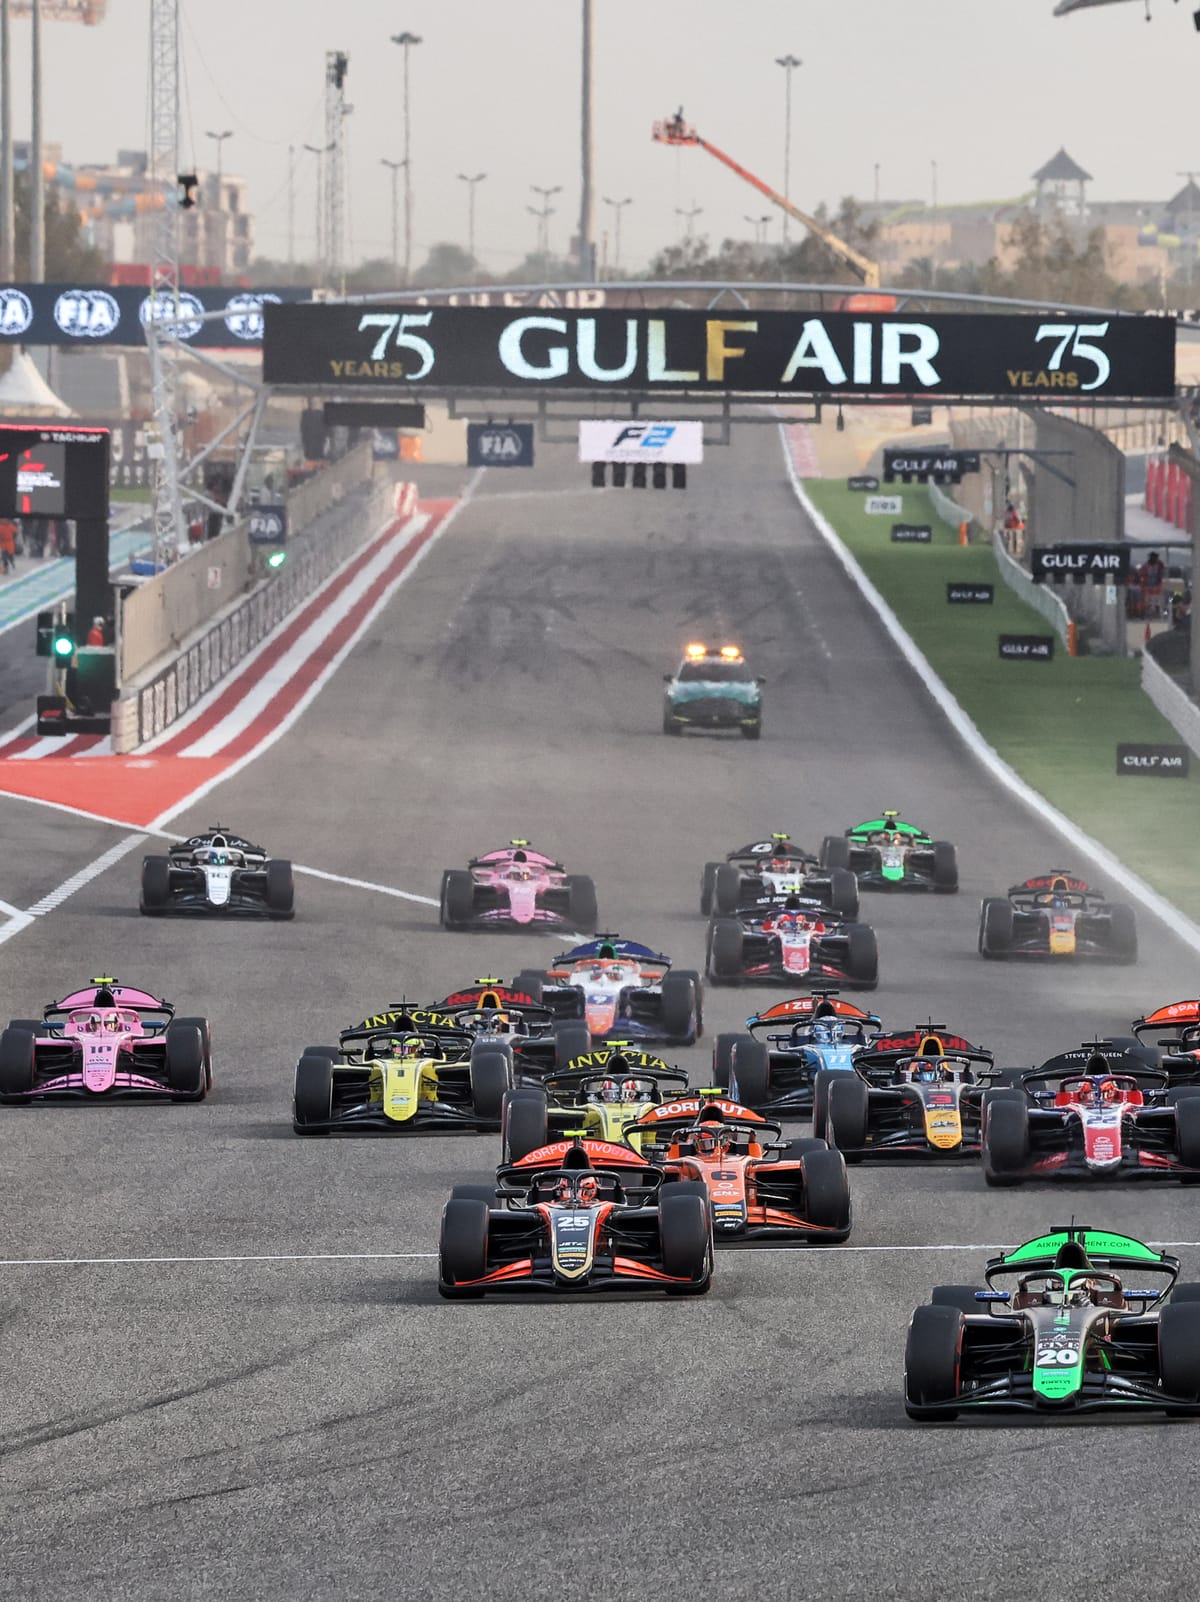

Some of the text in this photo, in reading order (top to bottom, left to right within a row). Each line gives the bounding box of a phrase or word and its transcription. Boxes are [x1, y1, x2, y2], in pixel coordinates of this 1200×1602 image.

[357, 311, 435, 380] 75
[499, 316, 941, 387] GULF AIR
[1034, 321, 1111, 390] 75
[330, 360, 402, 379] YEARS
[1007, 370, 1079, 388] YEARS
[613, 426, 676, 448] F2
[892, 458, 957, 471] GULF AIR
[1041, 554, 1120, 568] GULF AIR
[1123, 755, 1183, 767] GULF AIR
[364, 1011, 455, 1030] INVCTA
[877, 1031, 967, 1051] Red ull
[568, 1050, 668, 1070] INVCTA
[711, 1170, 738, 1181] 6
[557, 1216, 590, 1228] 25
[1036, 1240, 1131, 1249] AIXINMENT.COM
[1036, 1349, 1079, 1366] 20
